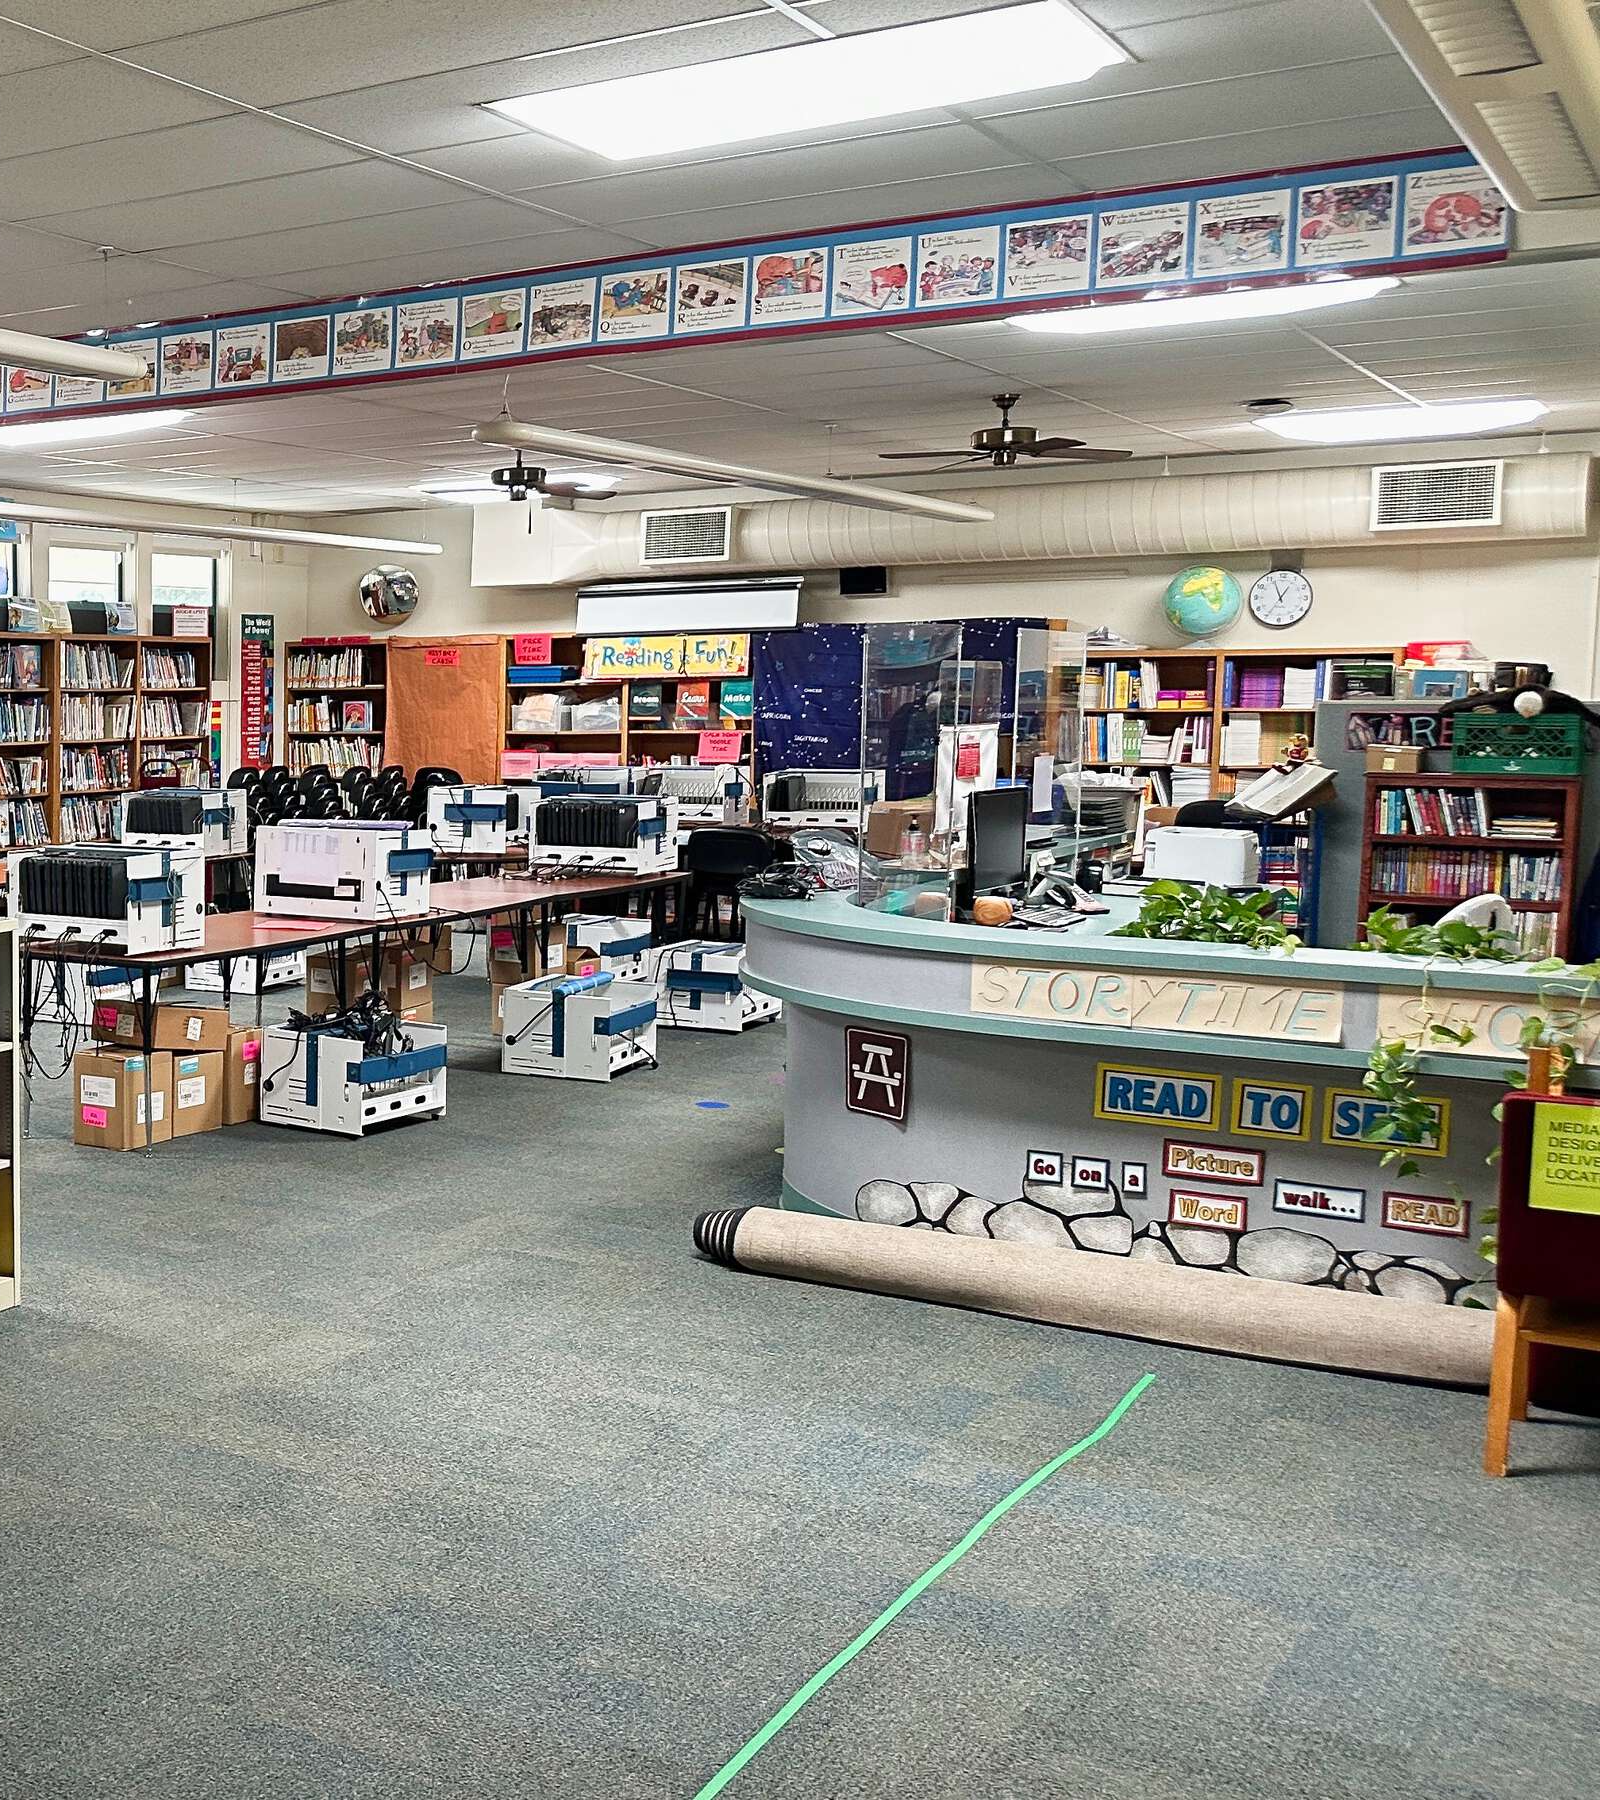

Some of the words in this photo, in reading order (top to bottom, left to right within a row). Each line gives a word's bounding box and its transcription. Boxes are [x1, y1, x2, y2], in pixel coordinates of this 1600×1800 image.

[1411, 176, 1423, 189] Z
[1200, 203, 1212, 215] X
[1102, 215, 1117, 227] W
[602, 646, 674, 670] Reading
[695, 641, 736, 665] Fun!
[724, 694, 750, 703] Make
[1410, 716, 1454, 747] RE
[978, 964, 1335, 1036] STORYTIME
[1107, 1076, 1209, 1118] READ
[1245, 1091, 1300, 1130] TO
[1335, 1100, 1440, 1143] SE
[1549, 1121, 1600, 1135] MEDIA
[1549, 1136, 1600, 1151] DESIG
[1171, 1148, 1255, 1176] Picture
[1548, 1152, 1600, 1167] DELIVE
[1033, 1158, 1056, 1178] Go
[1078, 1167, 1102, 1182] on
[1128, 1173, 1140, 1187] a
[1546, 1168, 1600, 1183] LOCAT
[1179, 1198, 1238, 1225] Word
[1391, 1200, 1460, 1227] READ
